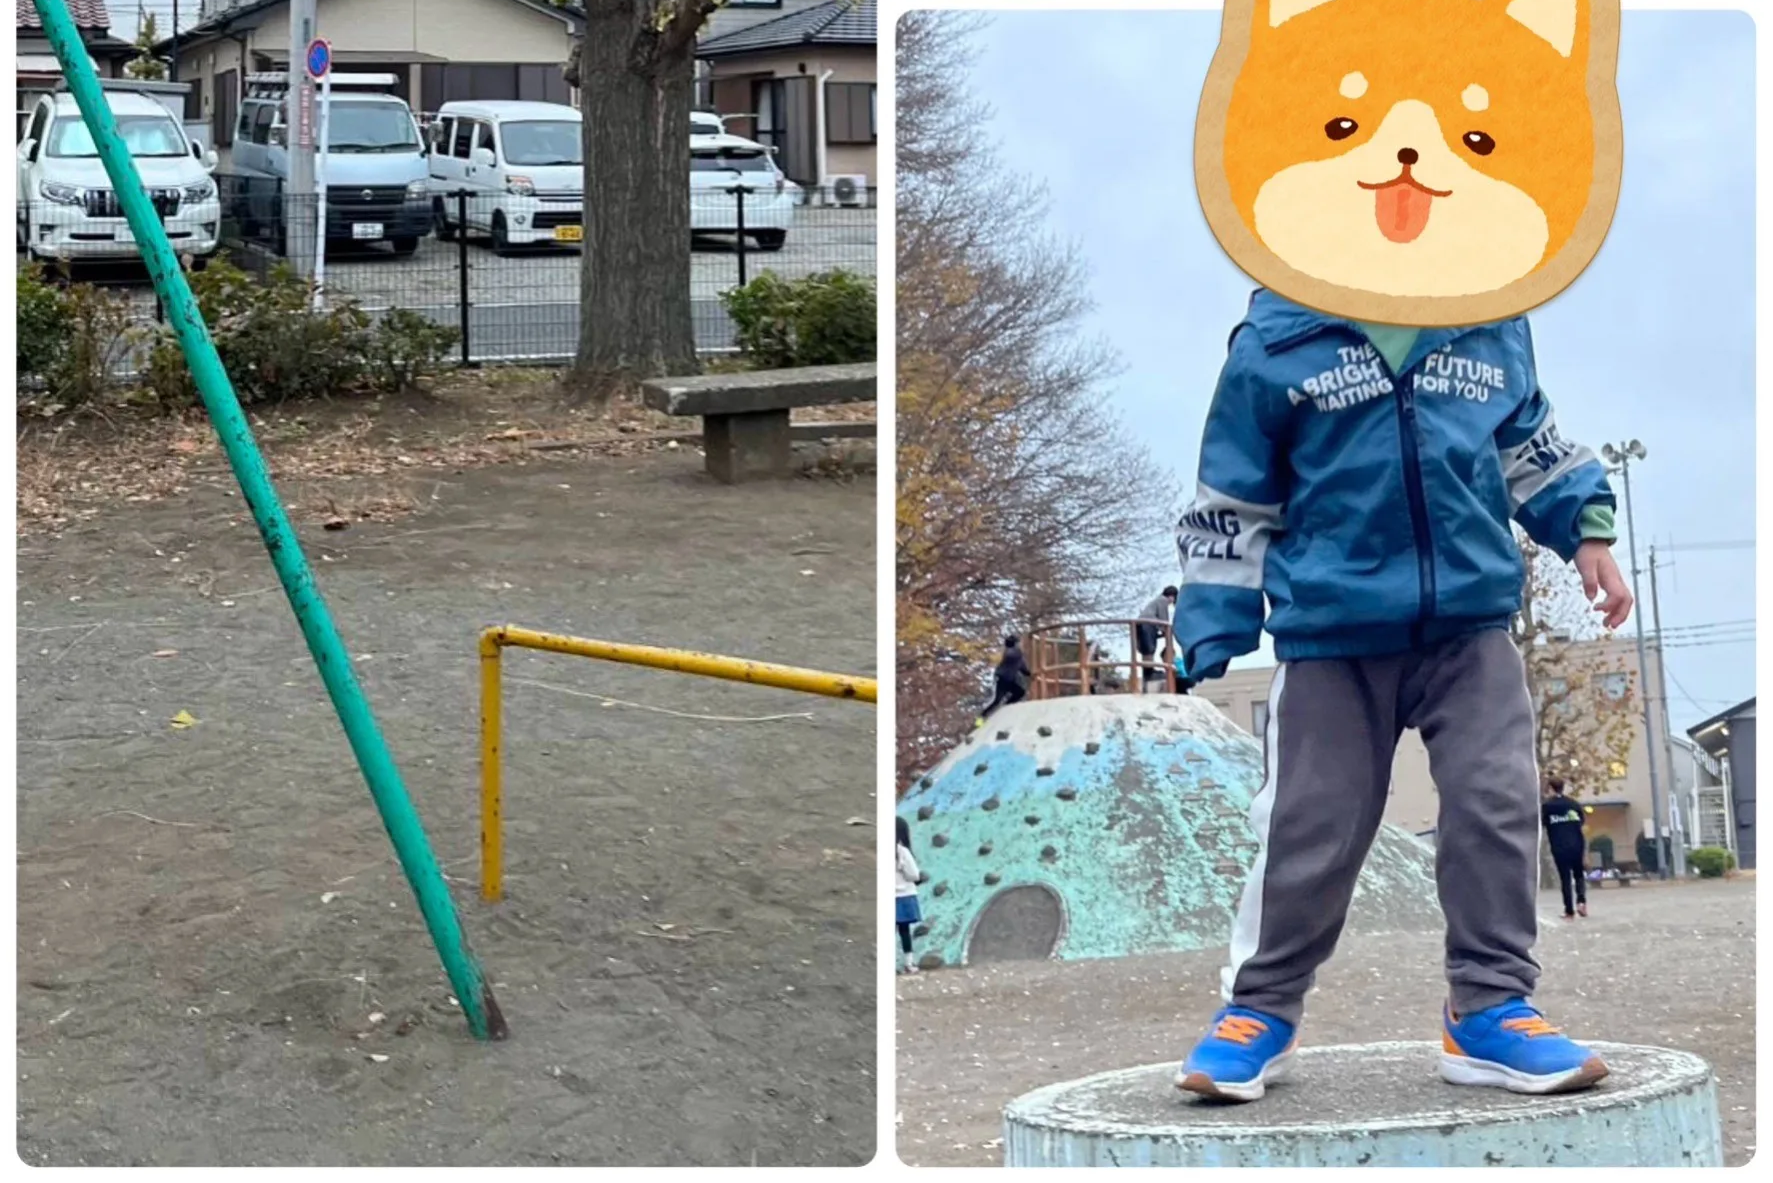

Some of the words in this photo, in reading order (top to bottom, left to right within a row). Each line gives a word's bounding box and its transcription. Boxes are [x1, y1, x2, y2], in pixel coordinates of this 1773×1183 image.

[1302, 358, 1383, 397] BRIGH
[1424, 354, 1504, 390] FUTURE
[1413, 373, 1450, 395] FOR
[1453, 380, 1489, 404] YOU
